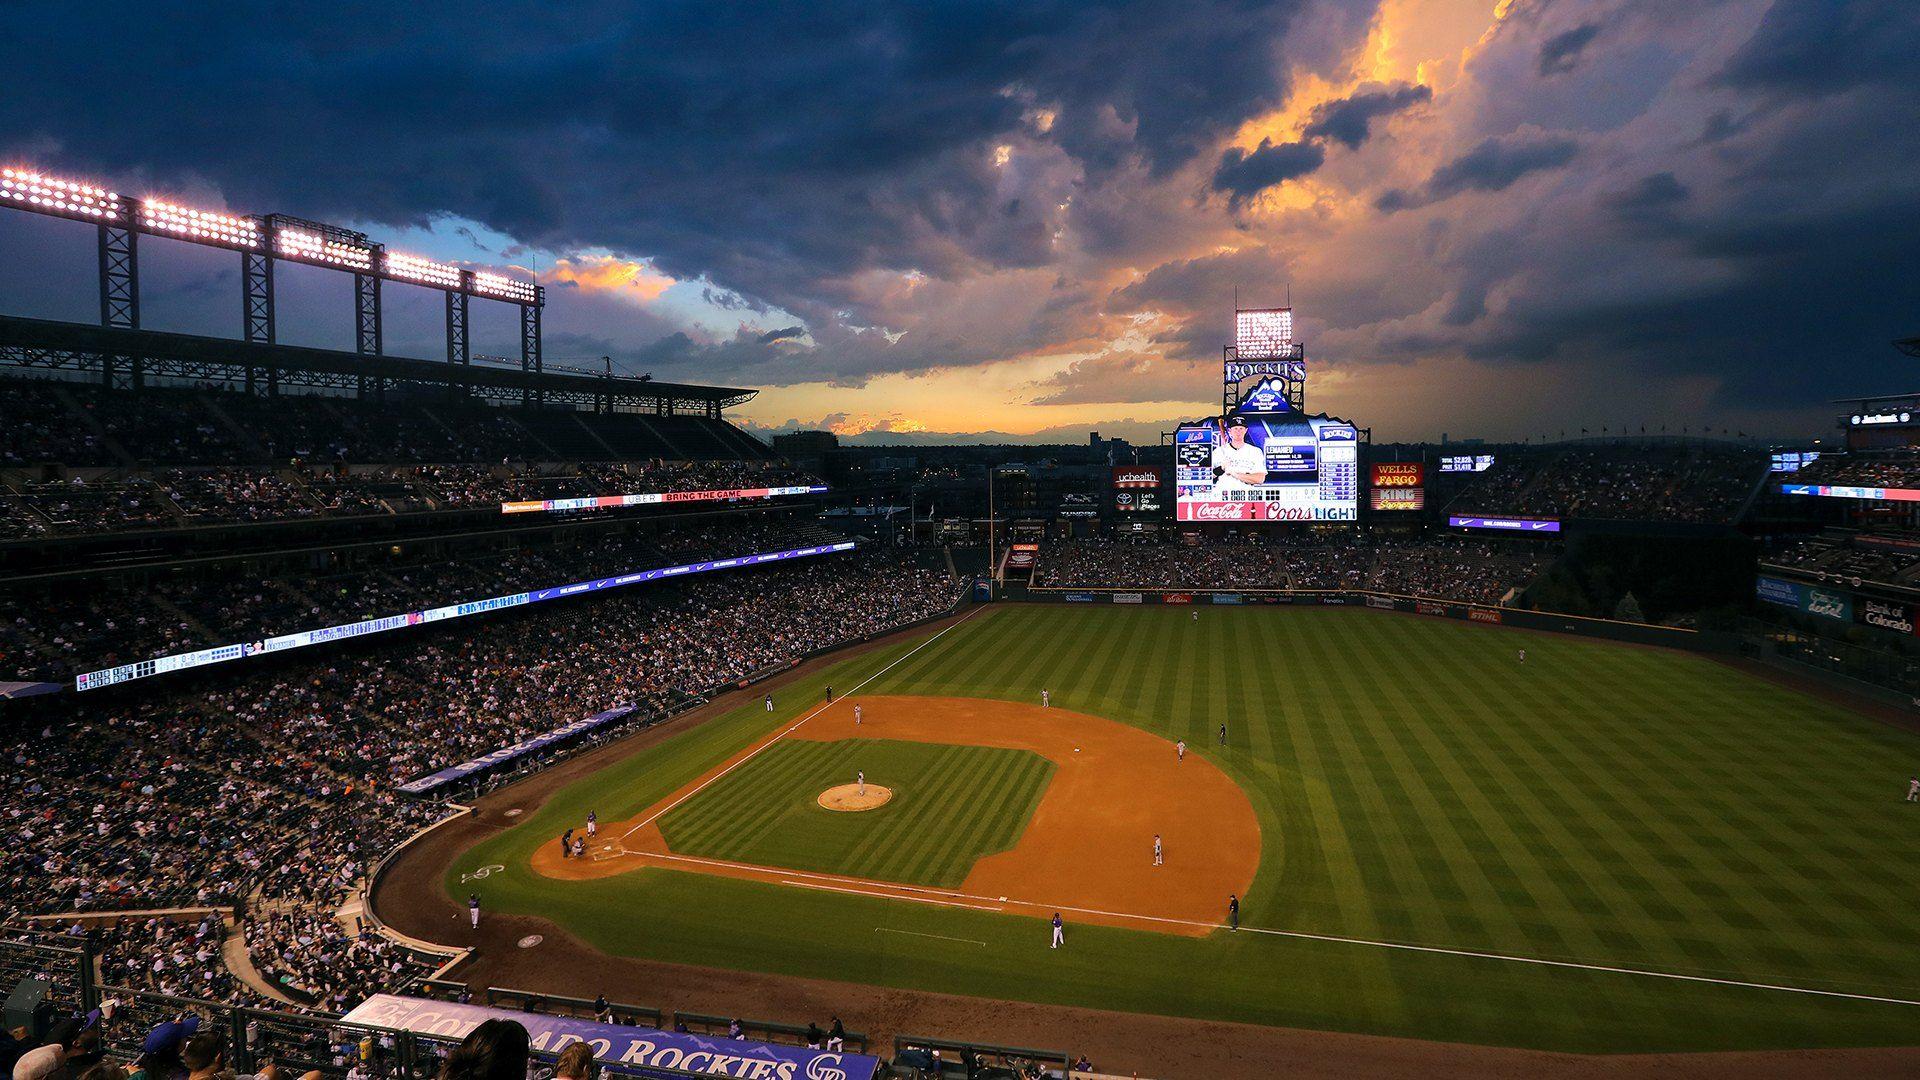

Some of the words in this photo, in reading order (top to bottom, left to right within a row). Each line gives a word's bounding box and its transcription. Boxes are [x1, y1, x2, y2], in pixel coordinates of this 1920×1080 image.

[1378, 465, 1418, 474] WELLS
[1118, 472, 1156, 482] uchealth
[1379, 475, 1417, 484] FARGO
[628, 494, 656, 504] UBER
[666, 492, 696, 501] BRING
[698, 491, 715, 500] THE
[717, 490, 742, 499] GAME
[1380, 488, 1415, 500] KING
[1196, 503, 1245, 519] Coca-Cola
[1265, 501, 1312, 520] Coors
[1314, 507, 1356, 520] LIGHT
[1866, 600, 1890, 616] Bank
[1471, 612, 1498, 622] STIHL
[1865, 612, 1913, 632] Colorado
[619, 1039, 798, 1080] ROCKIES
